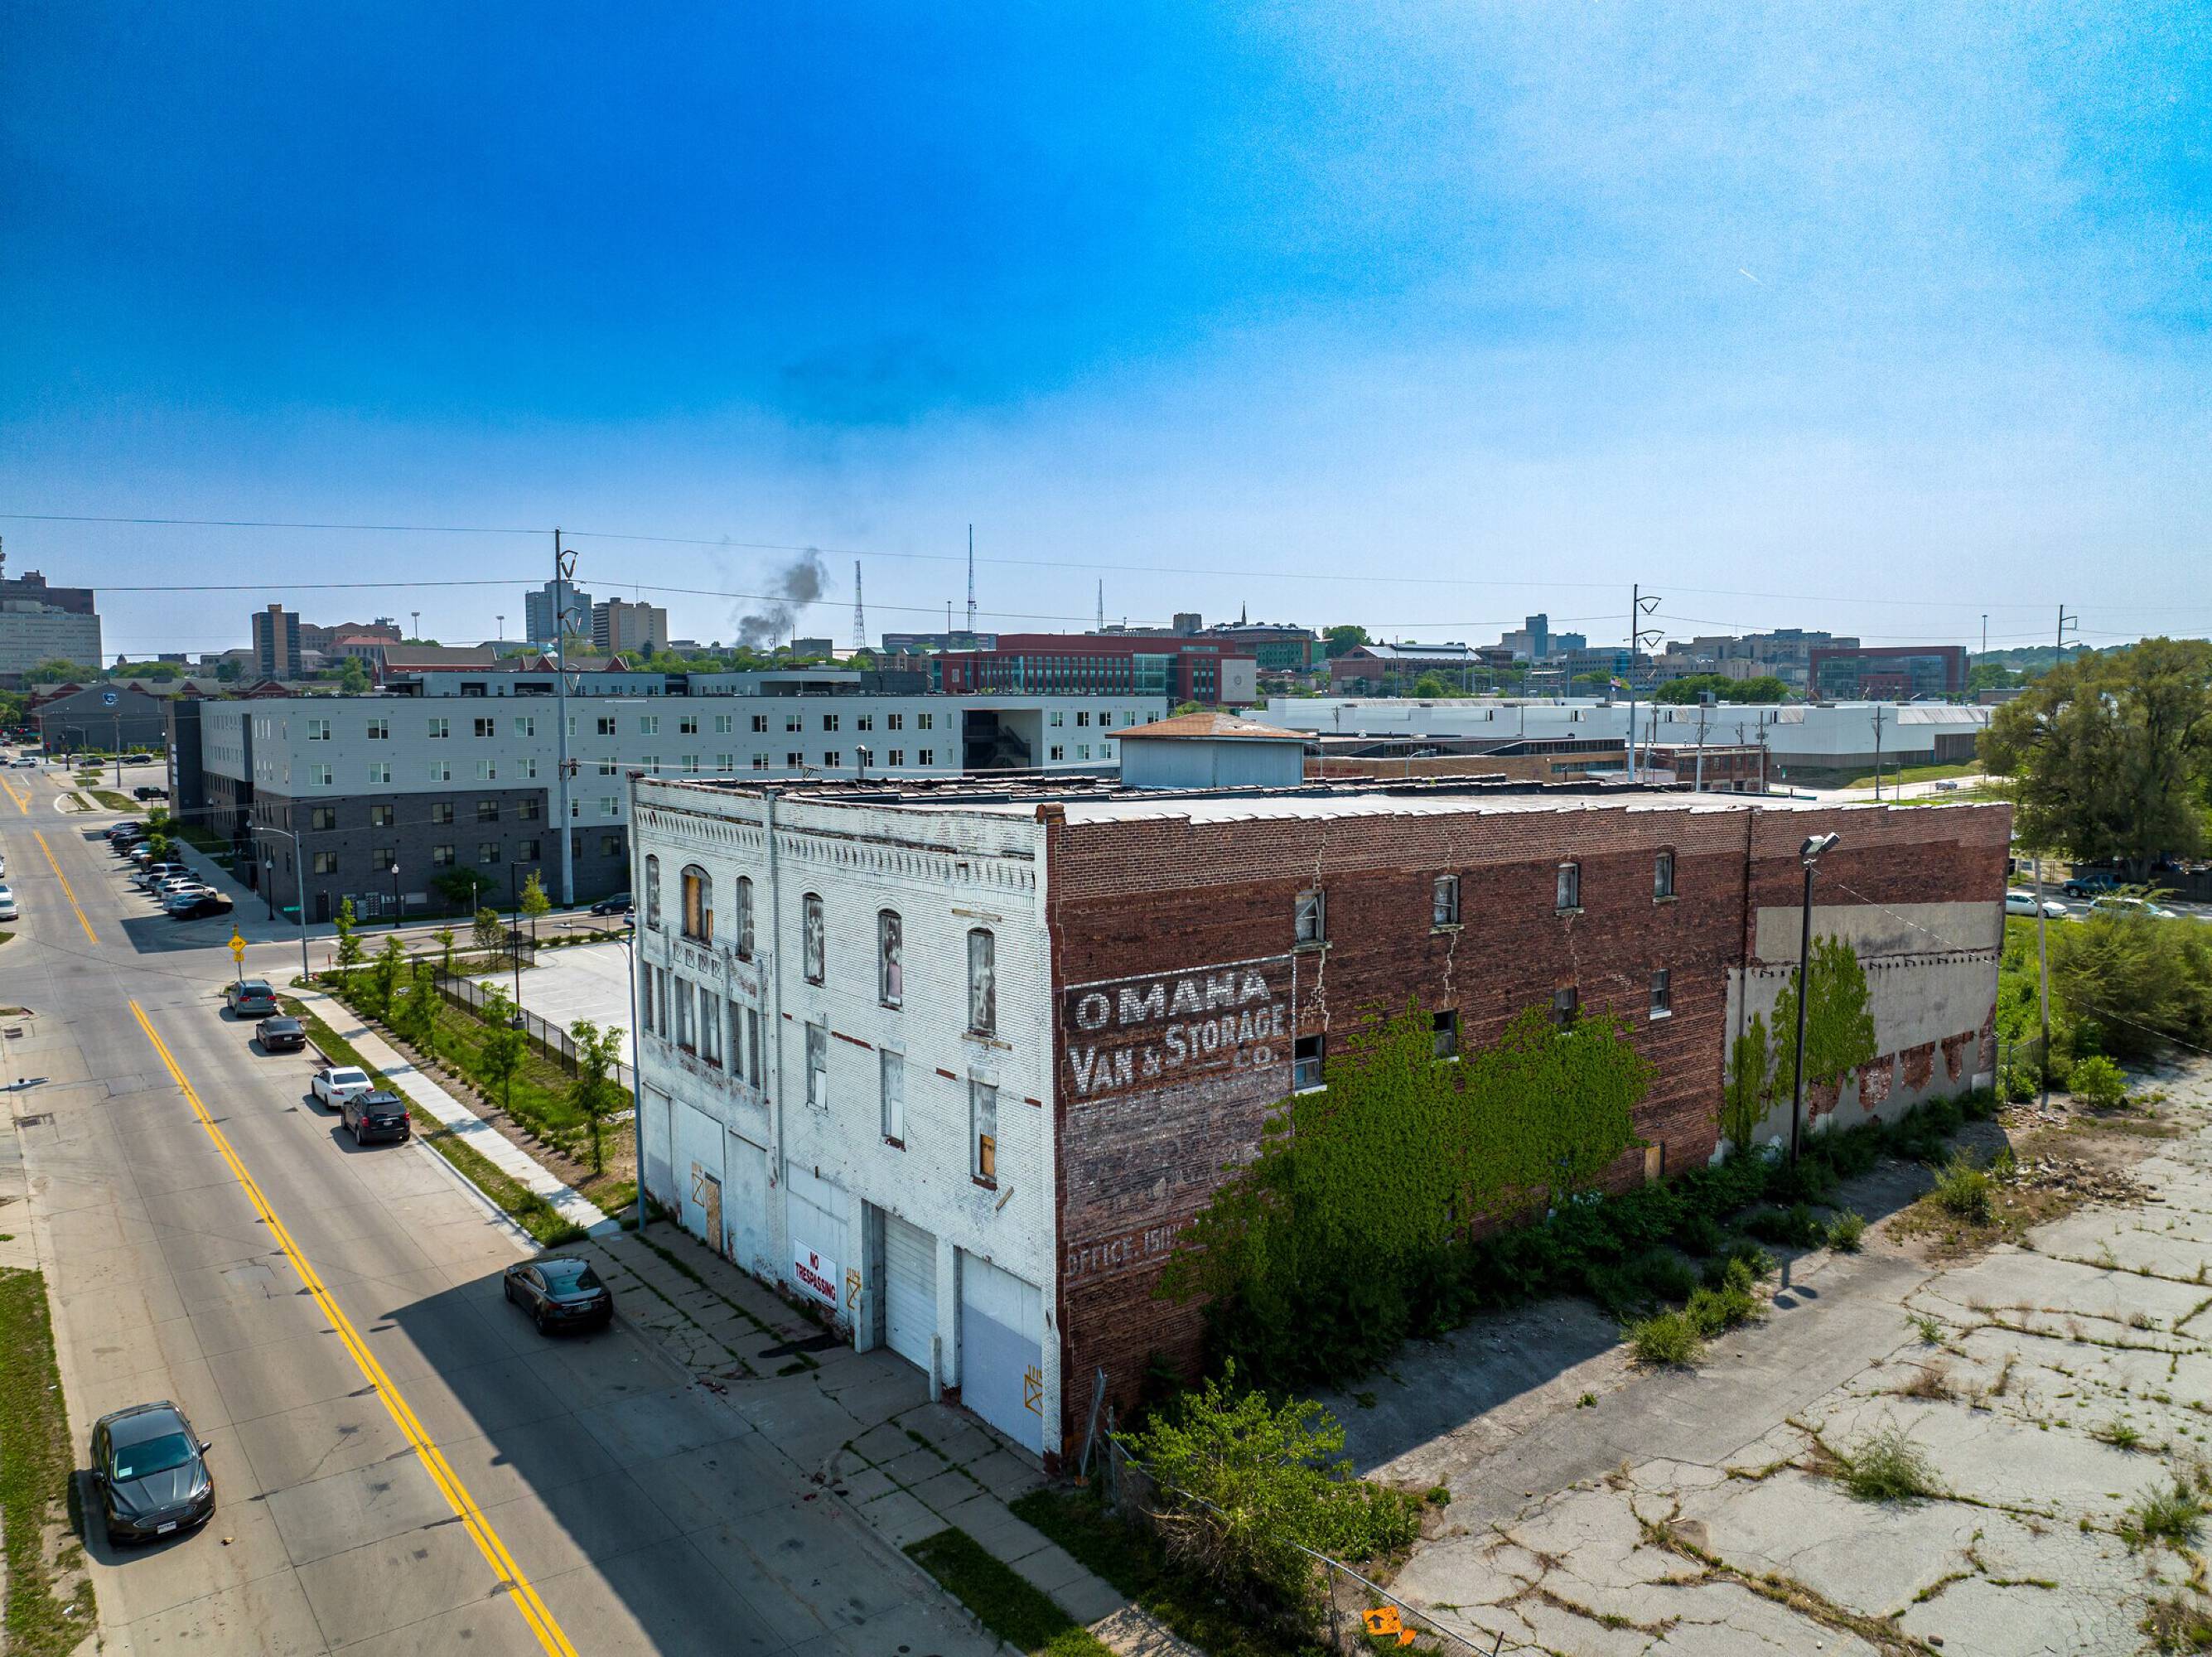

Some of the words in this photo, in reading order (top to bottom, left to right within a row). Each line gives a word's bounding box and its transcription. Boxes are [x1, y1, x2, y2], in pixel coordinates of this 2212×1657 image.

[1077, 969, 1270, 1030] OMAHA
[1068, 1046, 1133, 1094] VAN
[1142, 1046, 1161, 1075] &
[1166, 1003, 1286, 1066] STORAGE
[795, 1261, 836, 1301] TRESPASSING
[809, 1251, 819, 1270] NO
